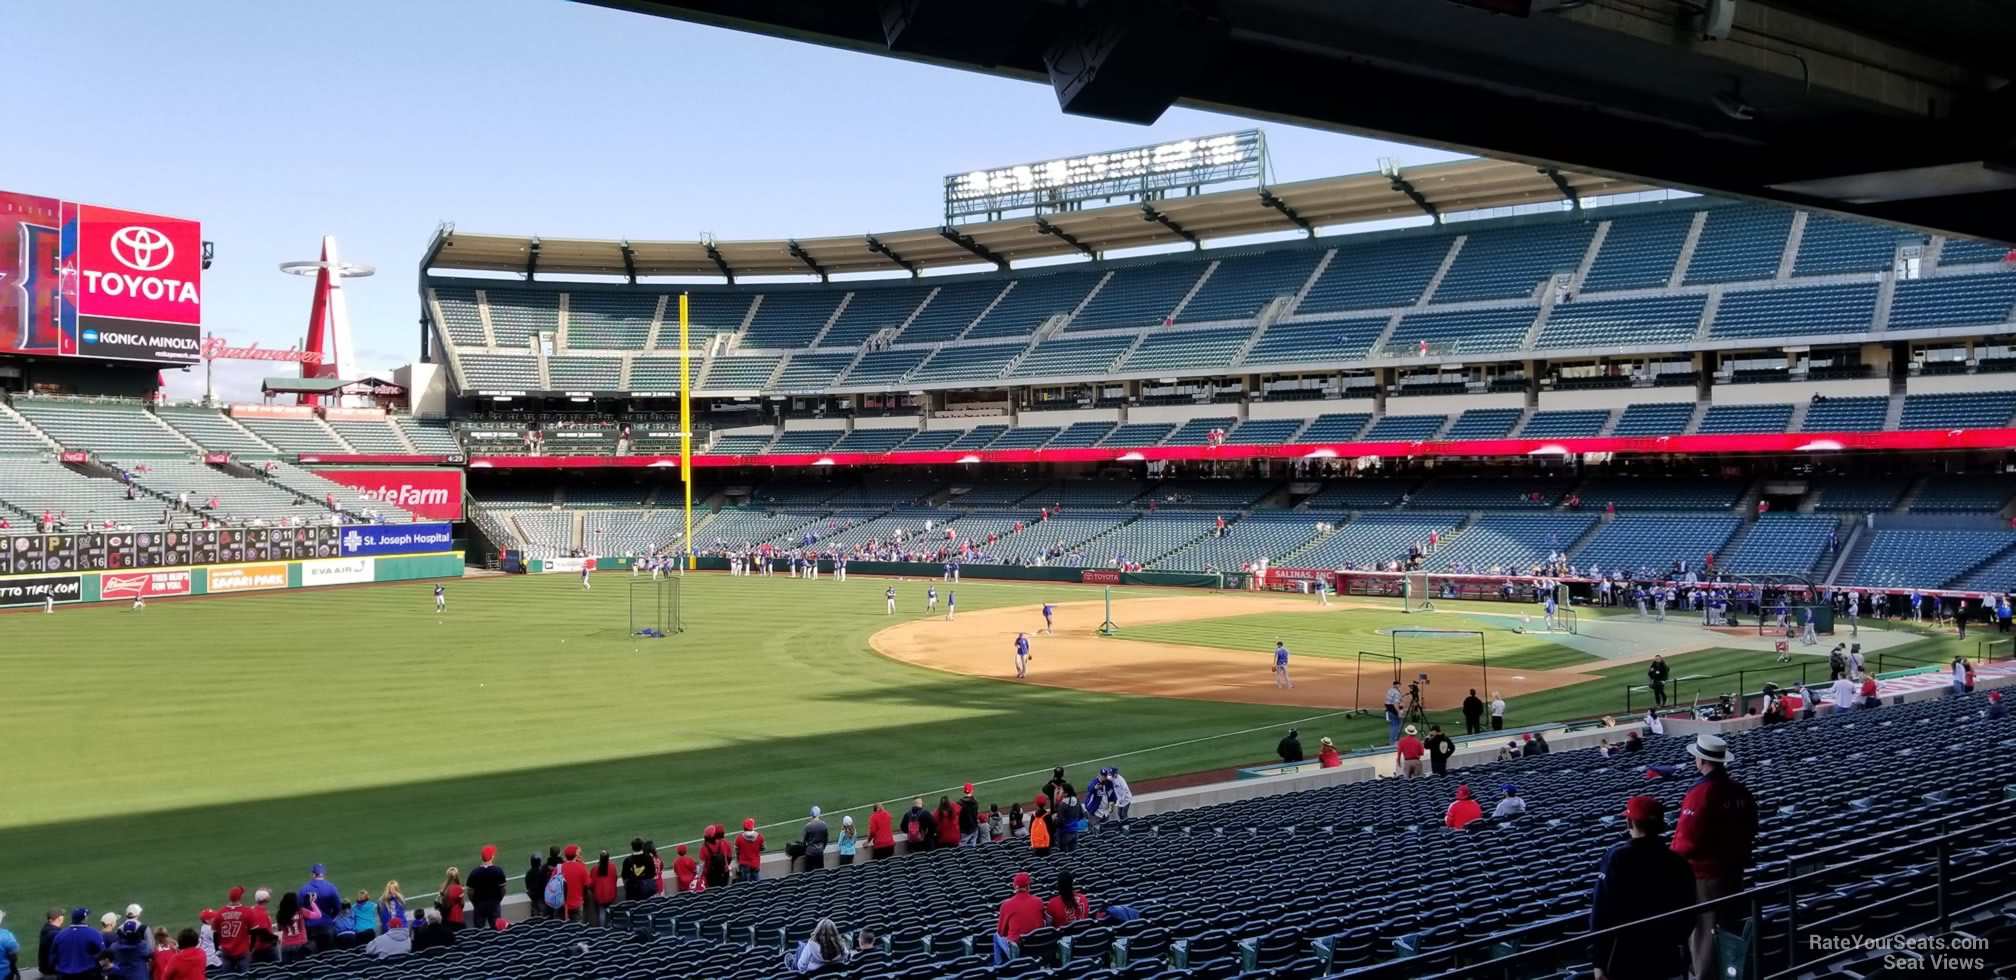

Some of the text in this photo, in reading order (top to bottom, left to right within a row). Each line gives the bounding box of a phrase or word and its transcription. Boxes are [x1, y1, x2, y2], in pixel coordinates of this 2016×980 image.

[83, 270, 199, 304] TOYOTA
[100, 332, 199, 350] KONICA MINOLTA
[399, 485, 448, 505] Farm
[208, 533, 215, 542] 6
[234, 532, 241, 541] 6
[260, 531, 267, 540] 2
[283, 531, 292, 539] 11
[308, 529, 315, 538] 8
[331, 529, 338, 537] 3
[33, 538, 39, 548] 1
[64, 537, 72, 547] 7
[95, 537, 101, 546] 1
[124, 535, 132, 545] 4
[154, 535, 160, 544] 5
[181, 534, 188, 543] 5
[363, 533, 450, 546] St. Joseph Hospital
[234, 551, 241, 560] 5
[260, 550, 267, 559] 4
[284, 549, 290, 557] 7
[308, 548, 315, 556] 3
[331, 547, 338, 555] 4
[124, 556, 131, 565] 6
[154, 555, 160, 564] 3
[182, 554, 187, 562] 1
[208, 553, 215, 561] 2
[1, 562, 6, 571] 1
[30, 560, 42, 570] 11
[64, 559, 71, 568] 4
[92, 557, 104, 567] 16
[152, 573, 168, 582] THIS
[254, 574, 284, 586] PARK
[1094, 573, 1119, 581] TOYOTA
[152, 583, 166, 591] FOR
[0, 587, 22, 597] TTO
[221, 921, 241, 937] 27
